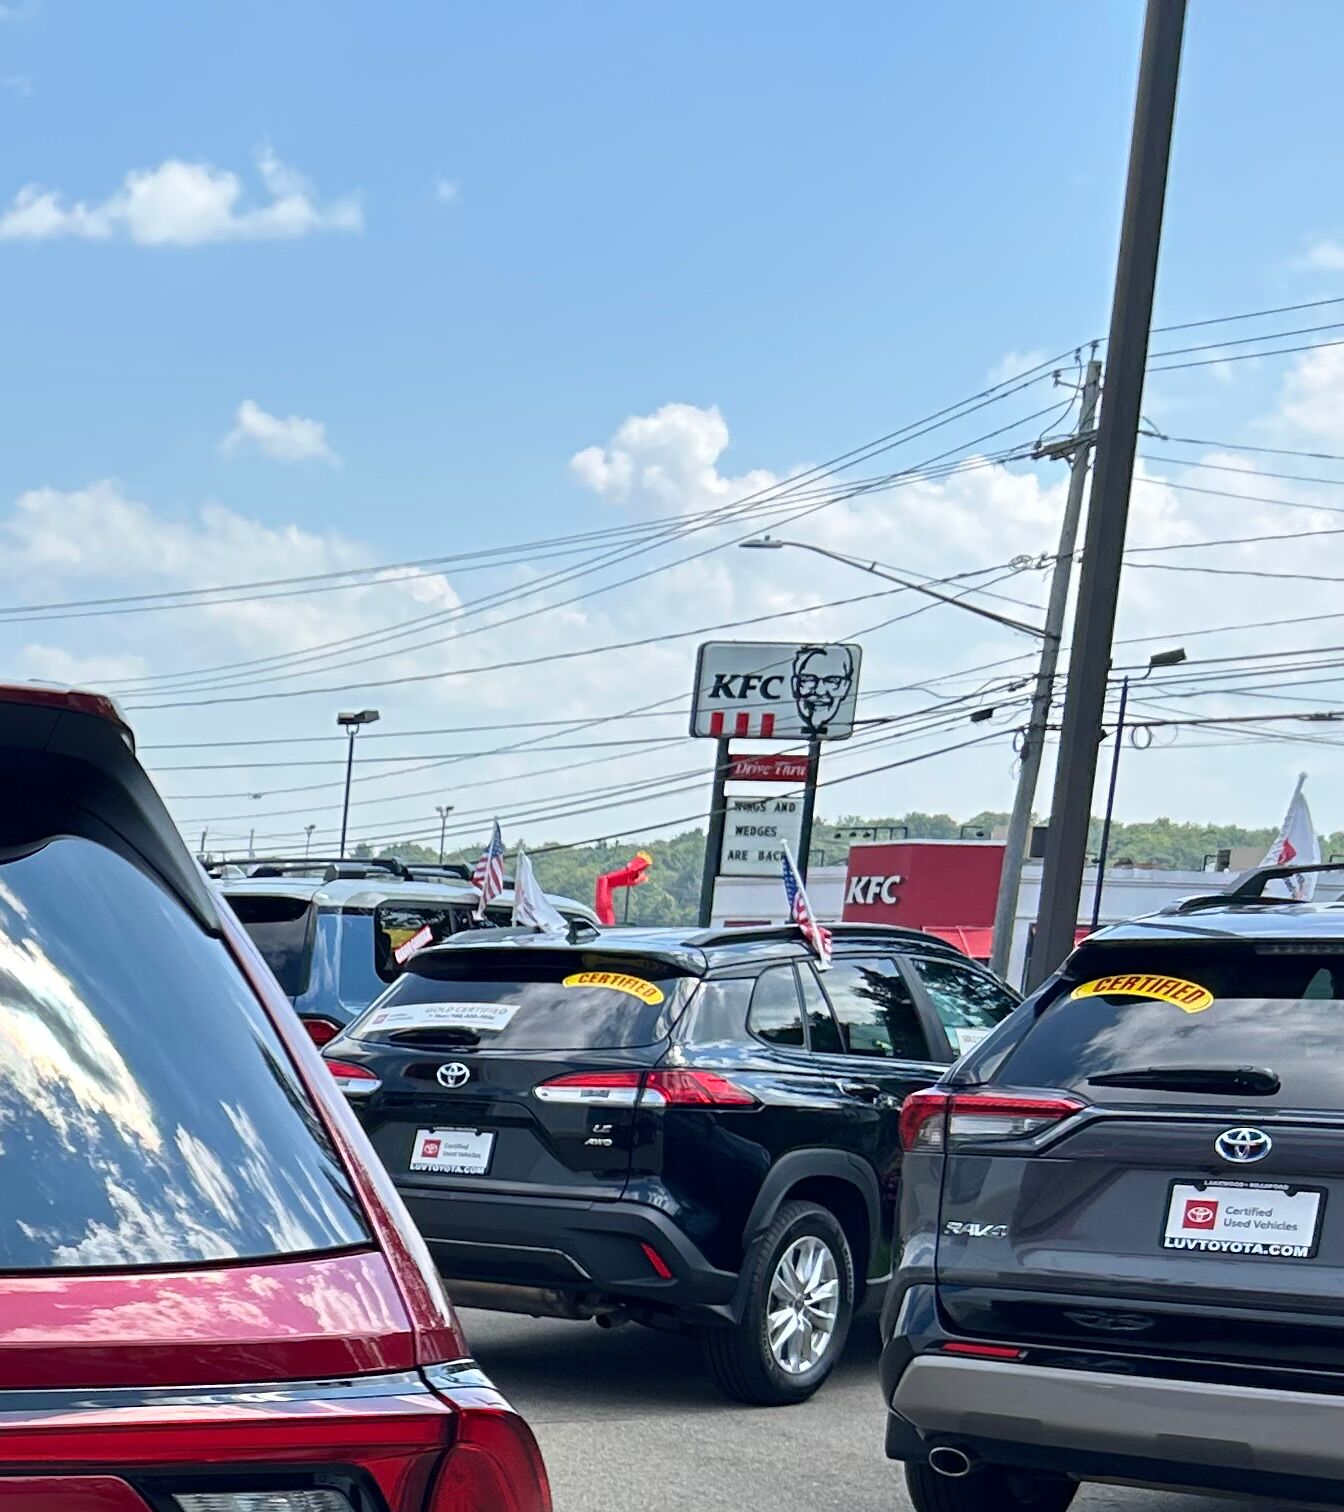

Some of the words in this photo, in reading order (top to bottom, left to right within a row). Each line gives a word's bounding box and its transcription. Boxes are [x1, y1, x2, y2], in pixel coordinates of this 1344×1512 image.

[708, 674, 785, 700] KFC
[734, 762, 771, 775] Drive
[774, 761, 807, 776] Thru
[734, 801, 767, 813] WINGS
[774, 802, 796, 813] AND
[735, 826, 778, 837] WEDGES
[727, 850, 749, 861] ARE
[844, 875, 901, 905] KFC
[578, 973, 657, 997] CERTIFIED
[1092, 976, 1206, 1004] CERTIFIED
[1225, 1206, 1274, 1217] Certified
[944, 1221, 1008, 1238] RAV4
[1223, 1218, 1252, 1228] Used
[1254, 1219, 1299, 1232] Vehicles
[1164, 1237, 1309, 1258] LUVTOYOTA.COM
